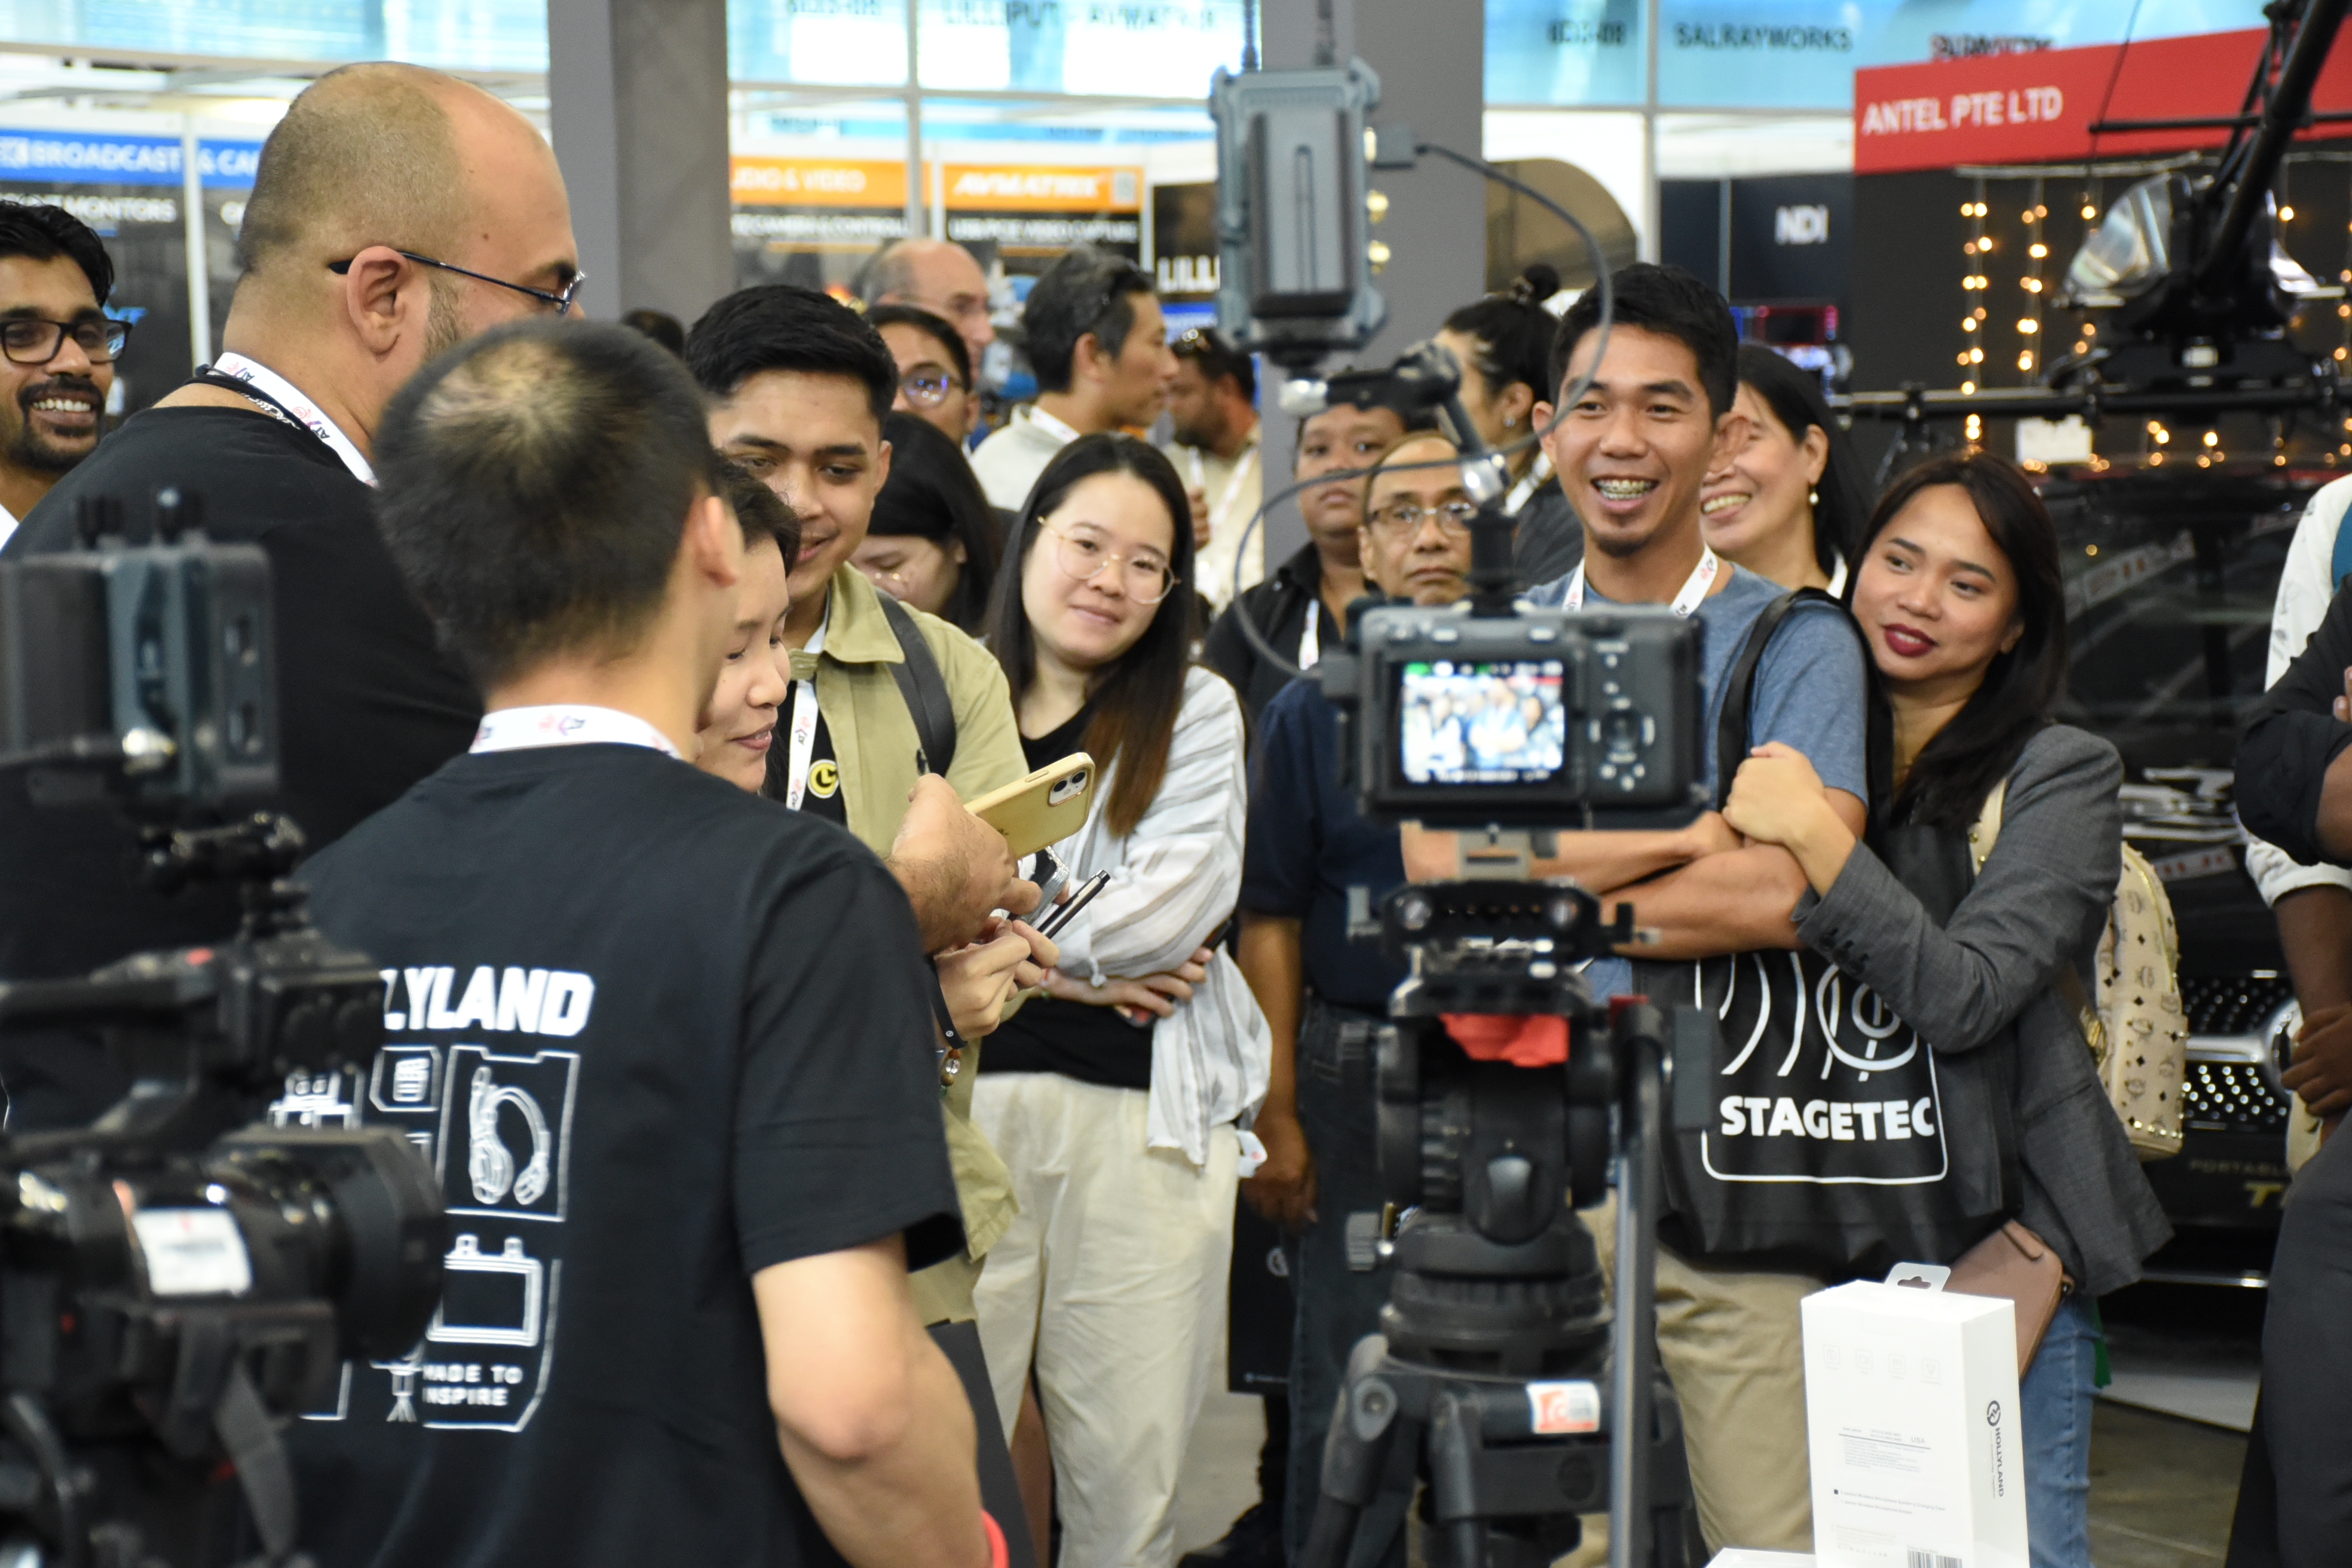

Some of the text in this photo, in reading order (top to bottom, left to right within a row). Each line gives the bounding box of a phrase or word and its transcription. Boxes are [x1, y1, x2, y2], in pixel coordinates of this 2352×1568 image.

[1860, 85, 2063, 136] ANTEL PTE LTD
[801, 169, 866, 193] VIDEO
[1774, 206, 1829, 244] NDI
[1720, 1096, 1936, 1141] STAGETEC
[490, 1365, 523, 1385] TO
[1995, 1427, 2005, 1497] HOLLYLAND
